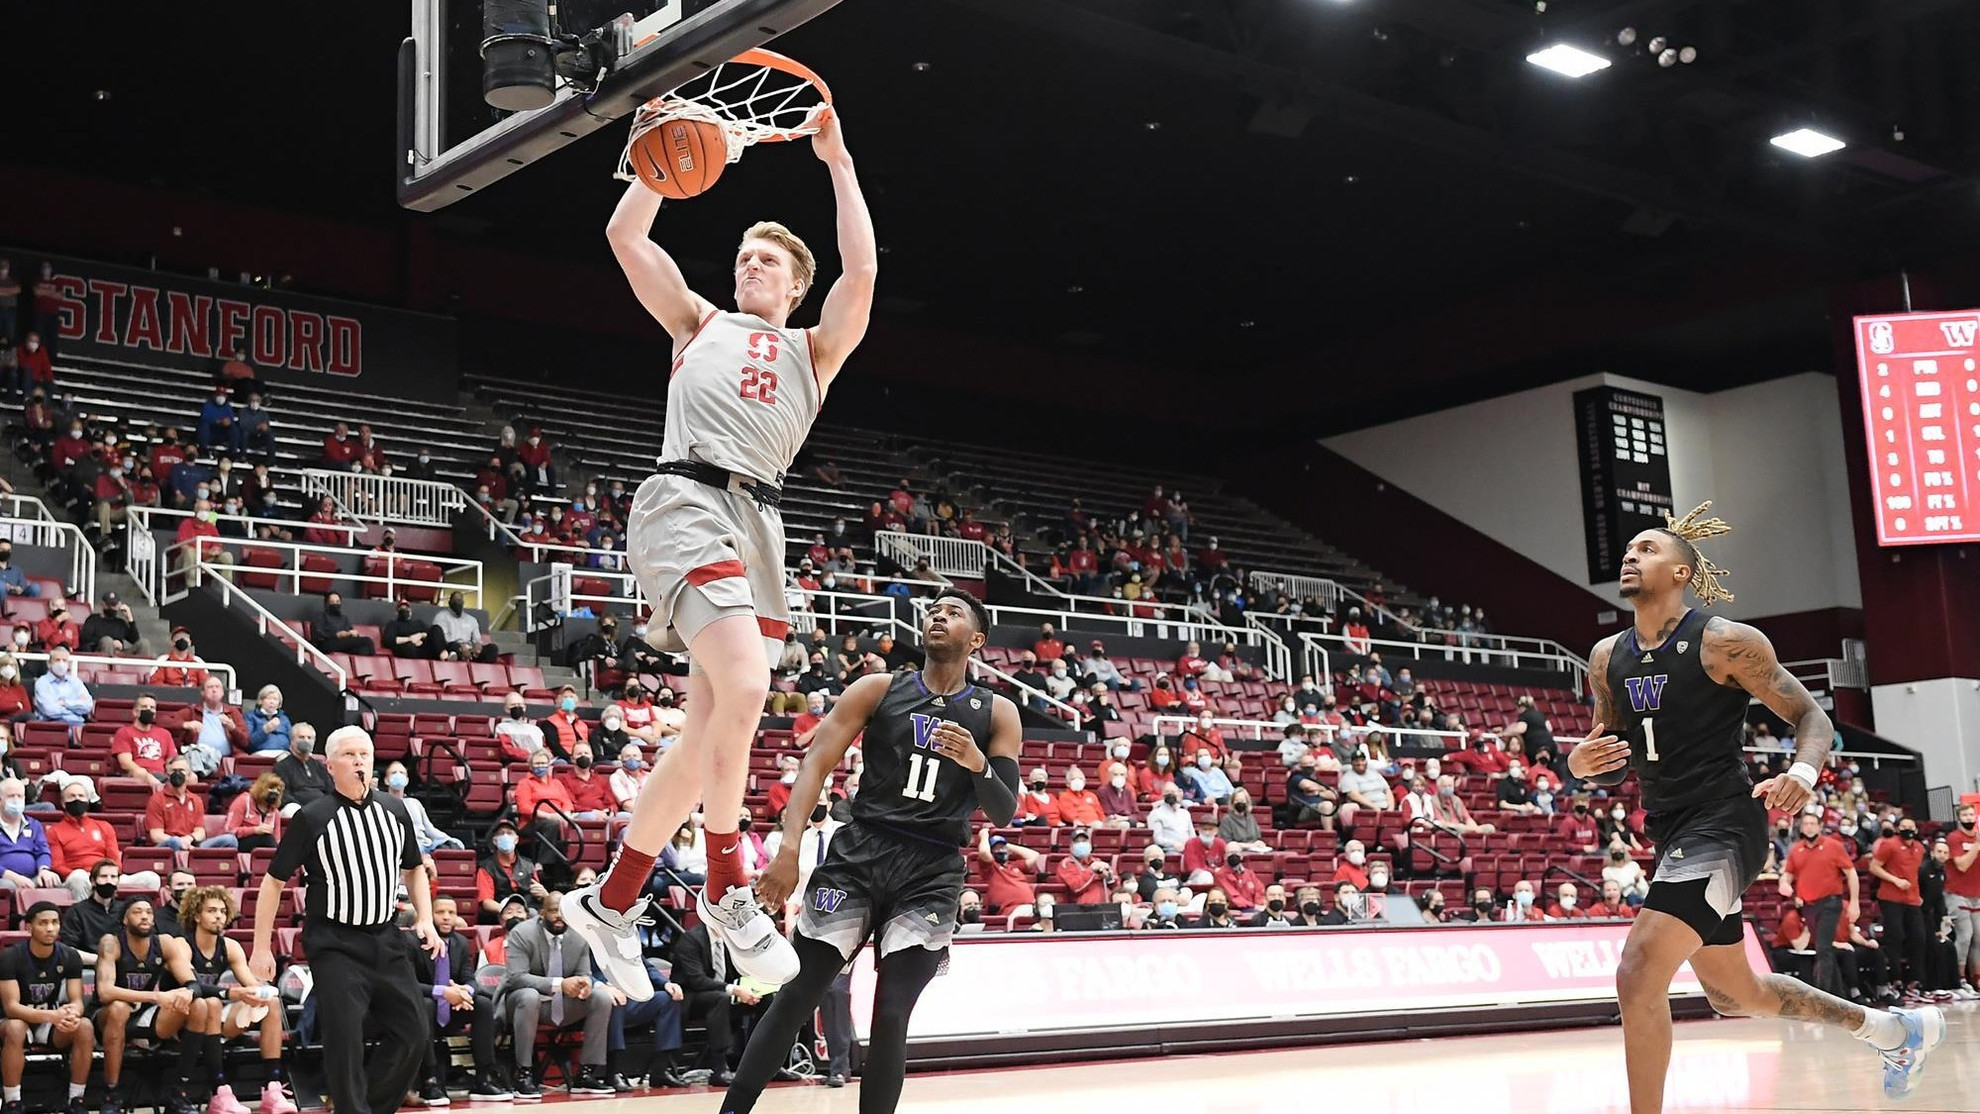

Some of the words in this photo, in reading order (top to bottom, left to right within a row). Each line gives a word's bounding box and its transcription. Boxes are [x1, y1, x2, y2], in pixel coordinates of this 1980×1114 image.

[671, 125, 693, 172] ELITE
[52, 275, 362, 377] STANFORD
[740, 366, 778, 405] 22
[1625, 674, 1668, 712] W
[1641, 717, 1659, 761] 1
[902, 753, 940, 803] 11
[814, 887, 847, 914] W
[1243, 949, 1381, 993] WELLS
[1380, 943, 1500, 986] FARGO
